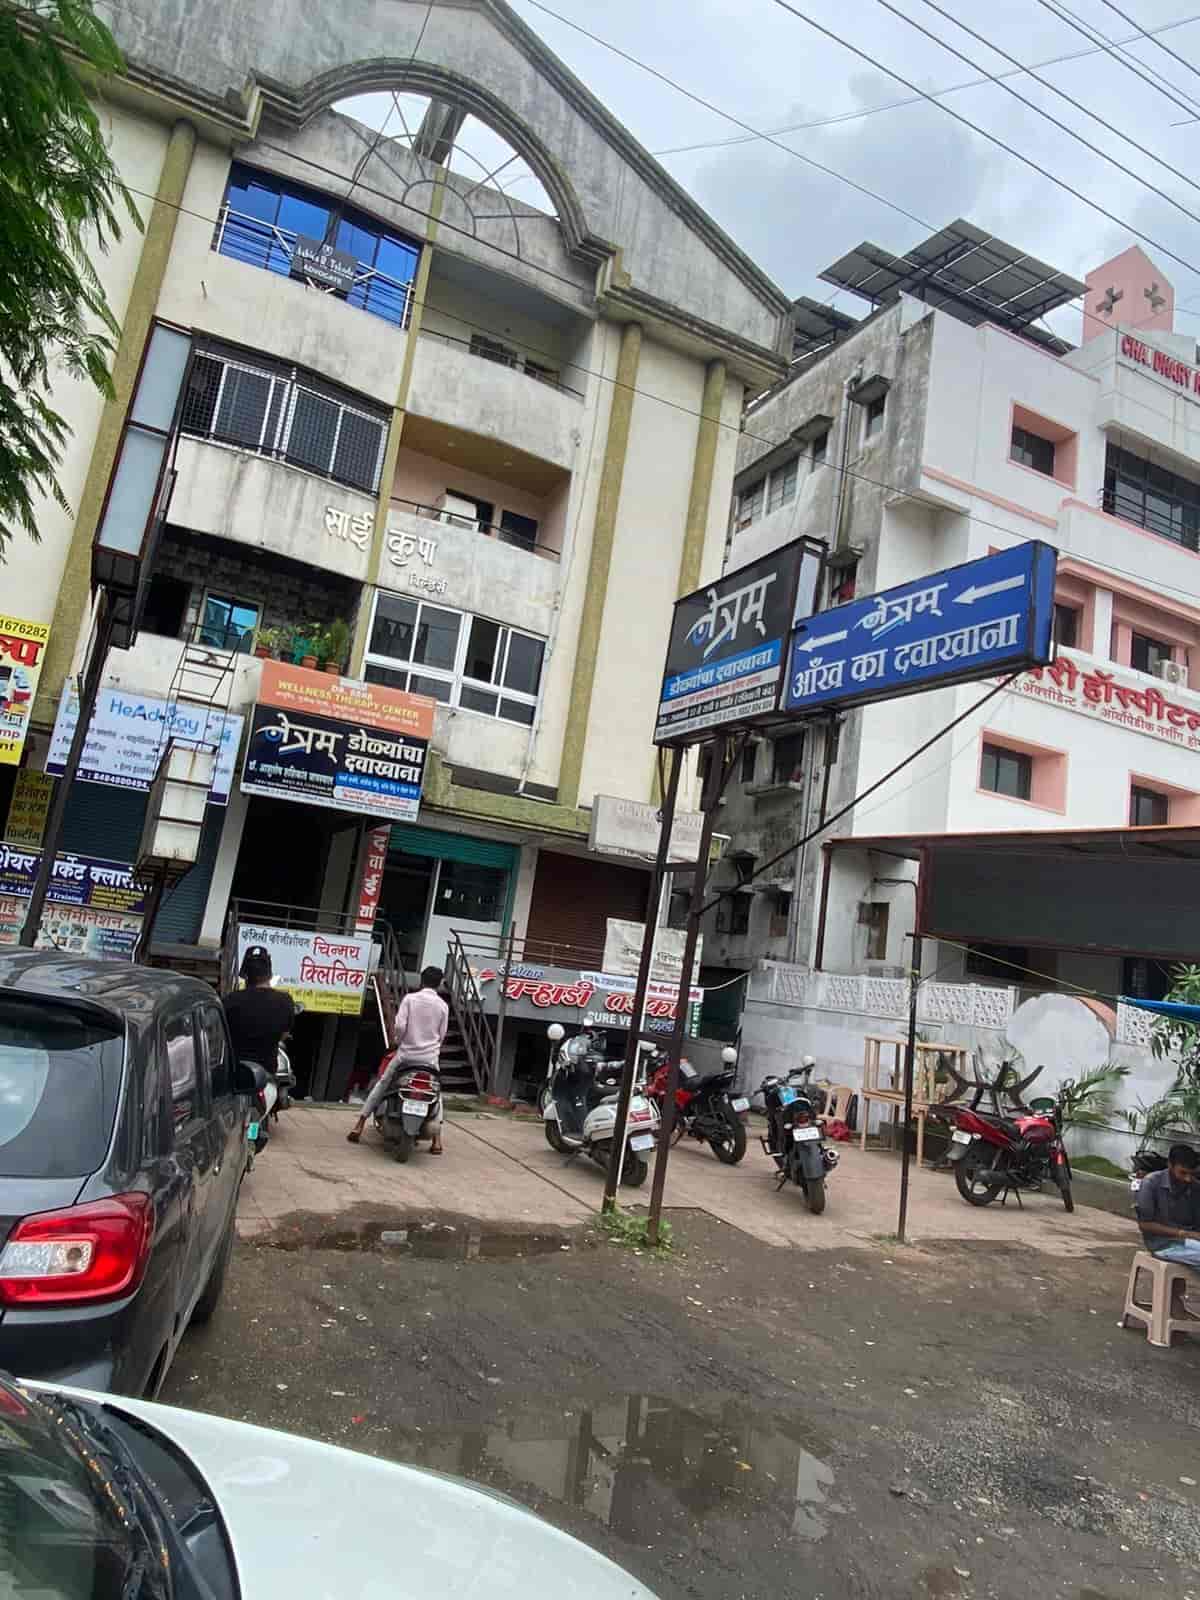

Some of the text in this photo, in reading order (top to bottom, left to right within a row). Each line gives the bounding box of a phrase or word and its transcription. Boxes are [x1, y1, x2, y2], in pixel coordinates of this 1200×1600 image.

[850, 648, 888, 681] का
[893, 613, 1021, 673] दवाखाना
[382, 703, 419, 720] CENTER
[344, 752, 422, 783] दवाखाना
